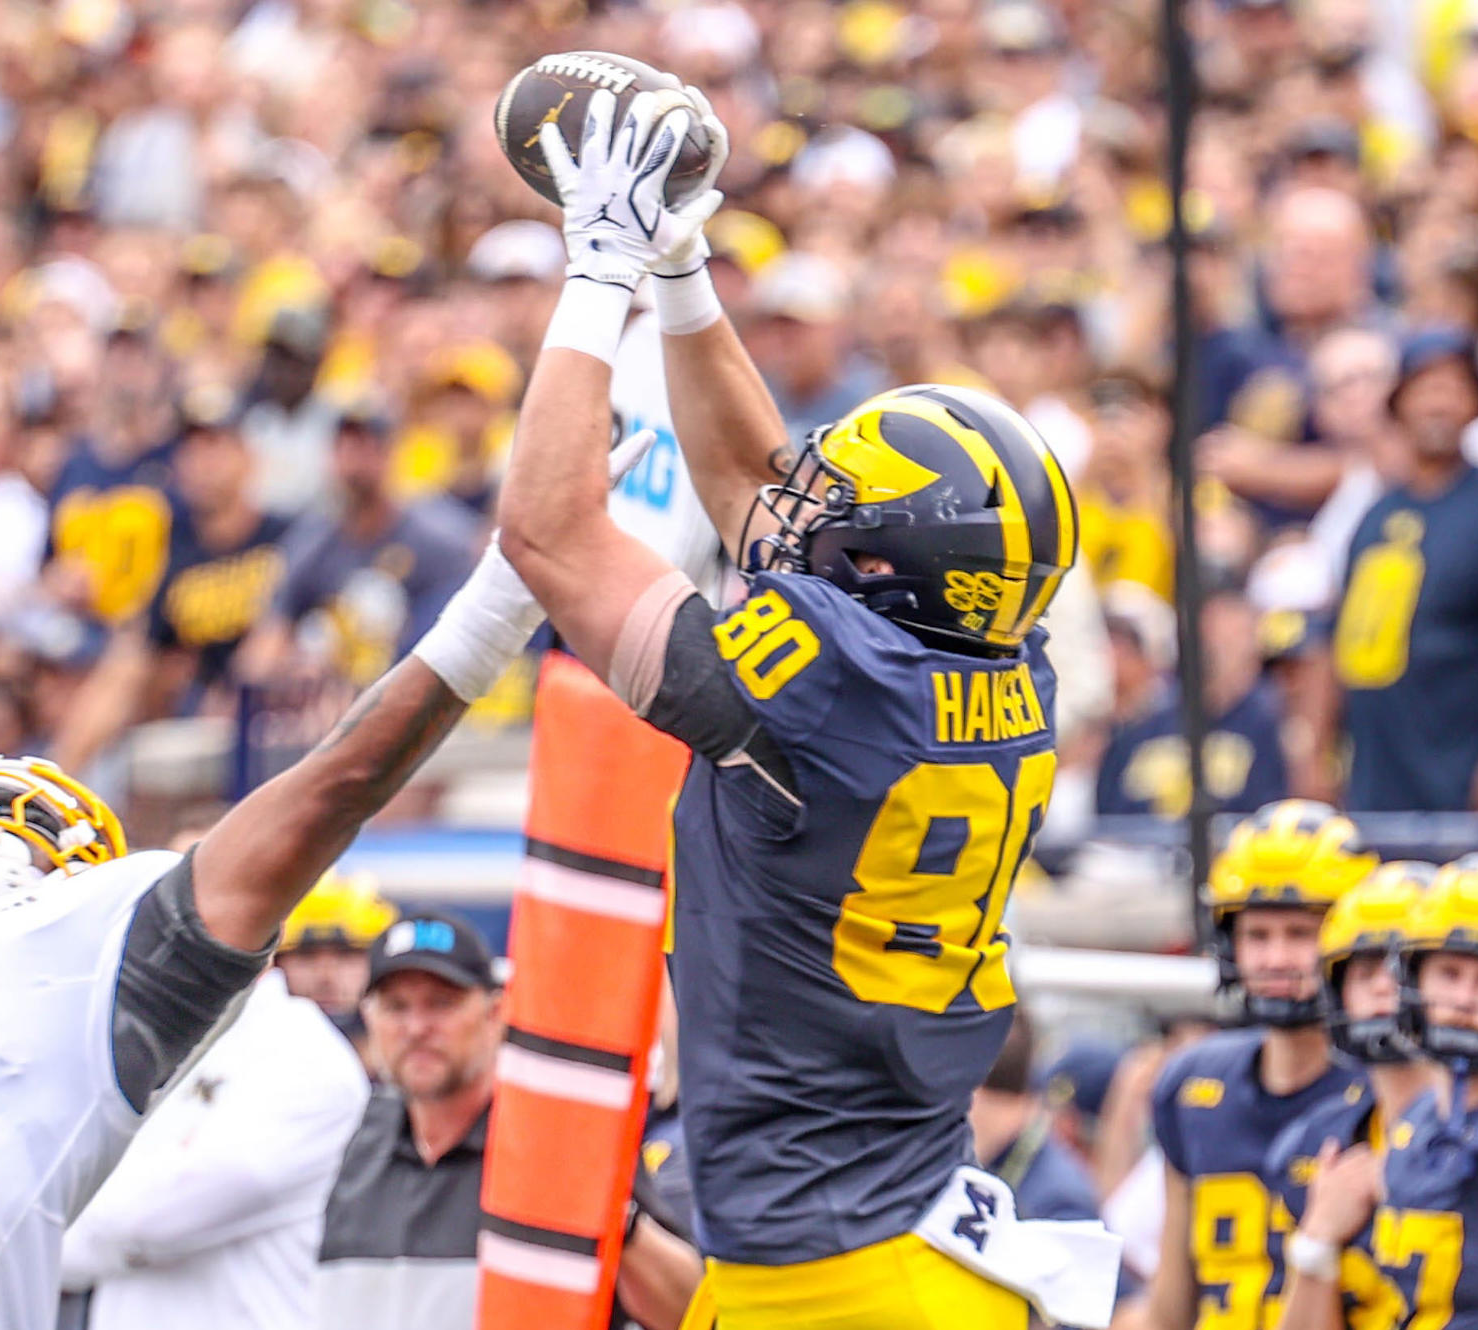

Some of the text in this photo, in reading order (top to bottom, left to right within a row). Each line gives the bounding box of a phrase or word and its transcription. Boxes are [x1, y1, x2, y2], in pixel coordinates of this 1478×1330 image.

[712, 588, 821, 700] 80
[930, 662, 1049, 743] HANSEN
[953, 1180, 997, 1253] M
